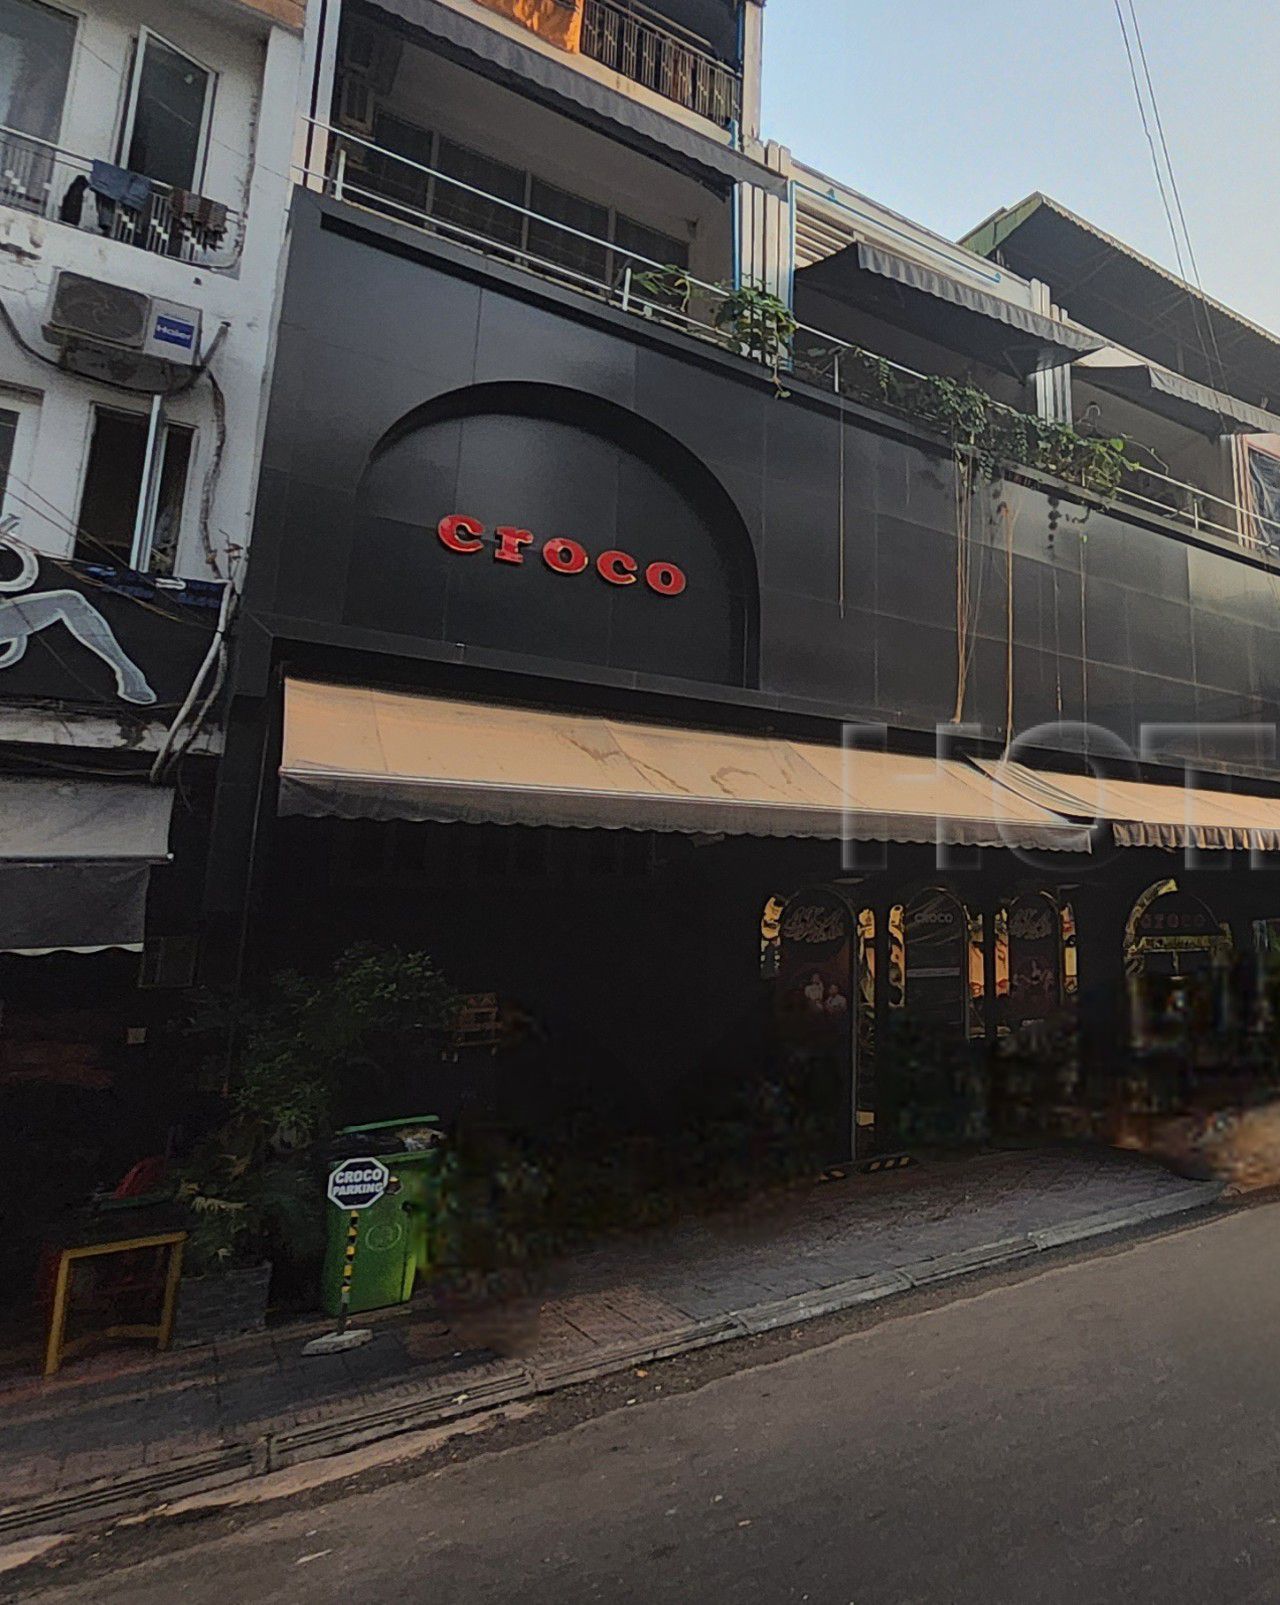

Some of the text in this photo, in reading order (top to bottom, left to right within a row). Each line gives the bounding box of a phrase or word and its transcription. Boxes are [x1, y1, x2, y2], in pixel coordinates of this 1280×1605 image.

[437, 513, 687, 596] croco
[335, 1168, 382, 1184] CROCO
[333, 1182, 383, 1196] PARKING
